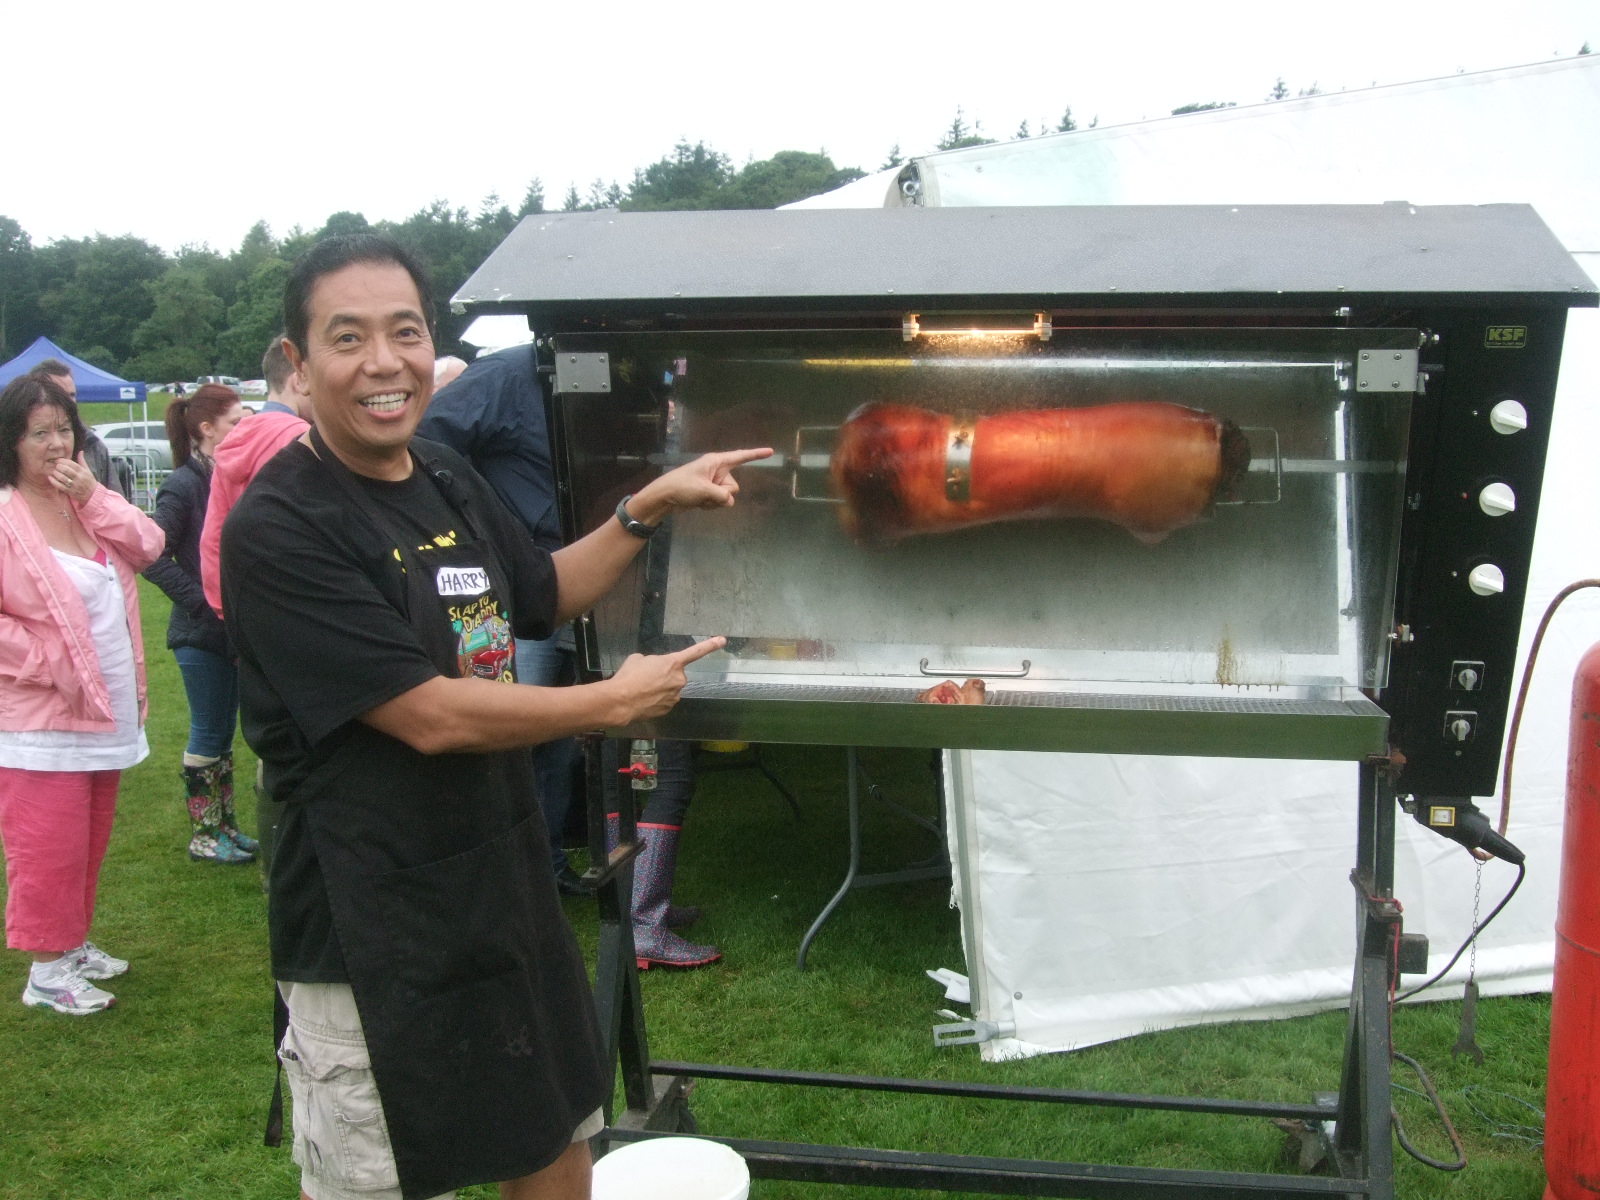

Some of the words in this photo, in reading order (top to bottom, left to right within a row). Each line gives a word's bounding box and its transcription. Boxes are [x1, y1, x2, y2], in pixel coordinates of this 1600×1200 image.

[1489, 328, 1525, 341] KSF
[441, 571, 488, 592] HARRY
[448, 602, 478, 622] SLAP
[462, 601, 498, 633] DADDY
